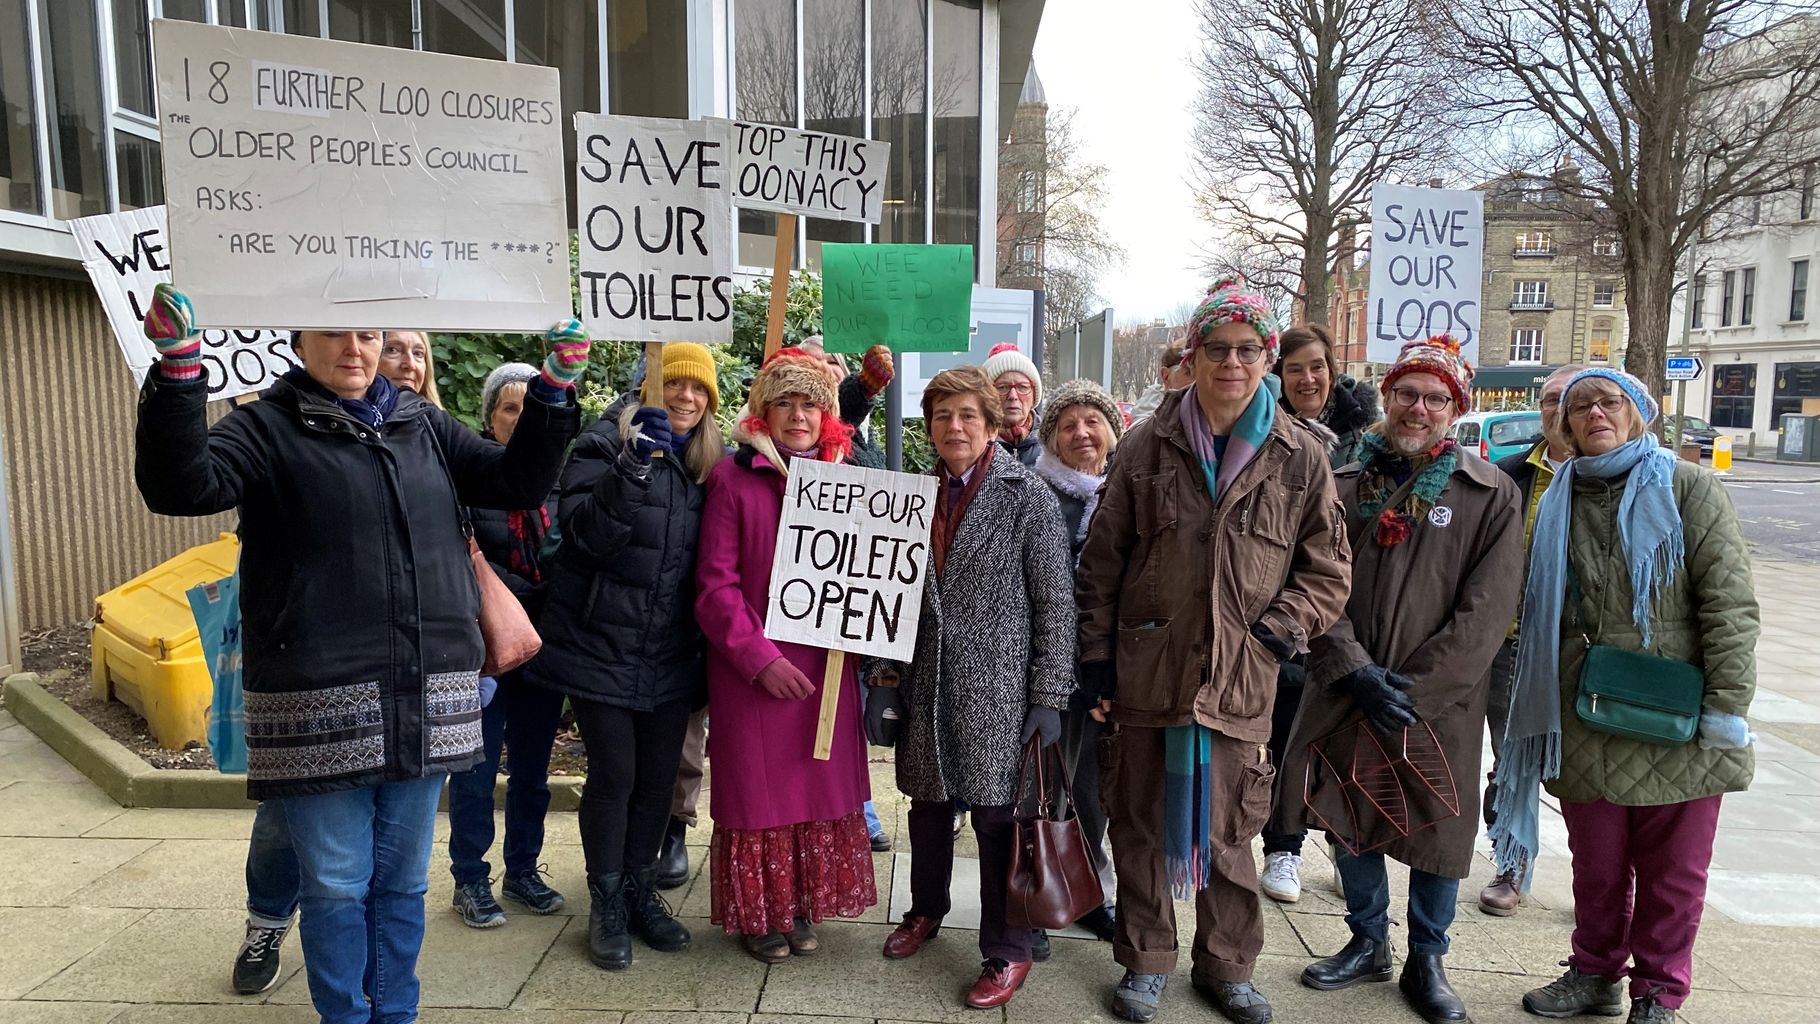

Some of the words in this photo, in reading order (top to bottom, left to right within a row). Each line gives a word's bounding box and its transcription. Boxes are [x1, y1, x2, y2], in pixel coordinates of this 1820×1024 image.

[169, 113, 191, 124] THE
[257, 67, 368, 114] FURTHER
[379, 82, 430, 118] LOO
[441, 90, 553, 125] CLOSURES
[189, 126, 296, 161] OLDER
[425, 146, 529, 174] COUNCIL
[580, 134, 721, 189] SAVE
[733, 122, 786, 161] TOP
[800, 134, 867, 176] THIS
[196, 186, 262, 212] ASKS:
[732, 162, 878, 218] OONACY
[288, 233, 337, 255] YOU
[344, 236, 433, 260] TAKING
[441, 240, 479, 261] THE
[586, 204, 708, 256] OUR
[1384, 204, 1469, 247] SAVE
[853, 251, 920, 277] WEE
[1388, 254, 1457, 290] OUR
[580, 271, 732, 322] TOILETS
[835, 279, 933, 304] NEED
[826, 312, 874, 336] OUR
[900, 313, 959, 336] LOOS
[1375, 297, 1477, 347] LOOS
[796, 477, 866, 514] KEEP
[868, 489, 926, 530] OUR
[788, 524, 925, 585] TOILETS
[779, 578, 903, 643] OPEN
